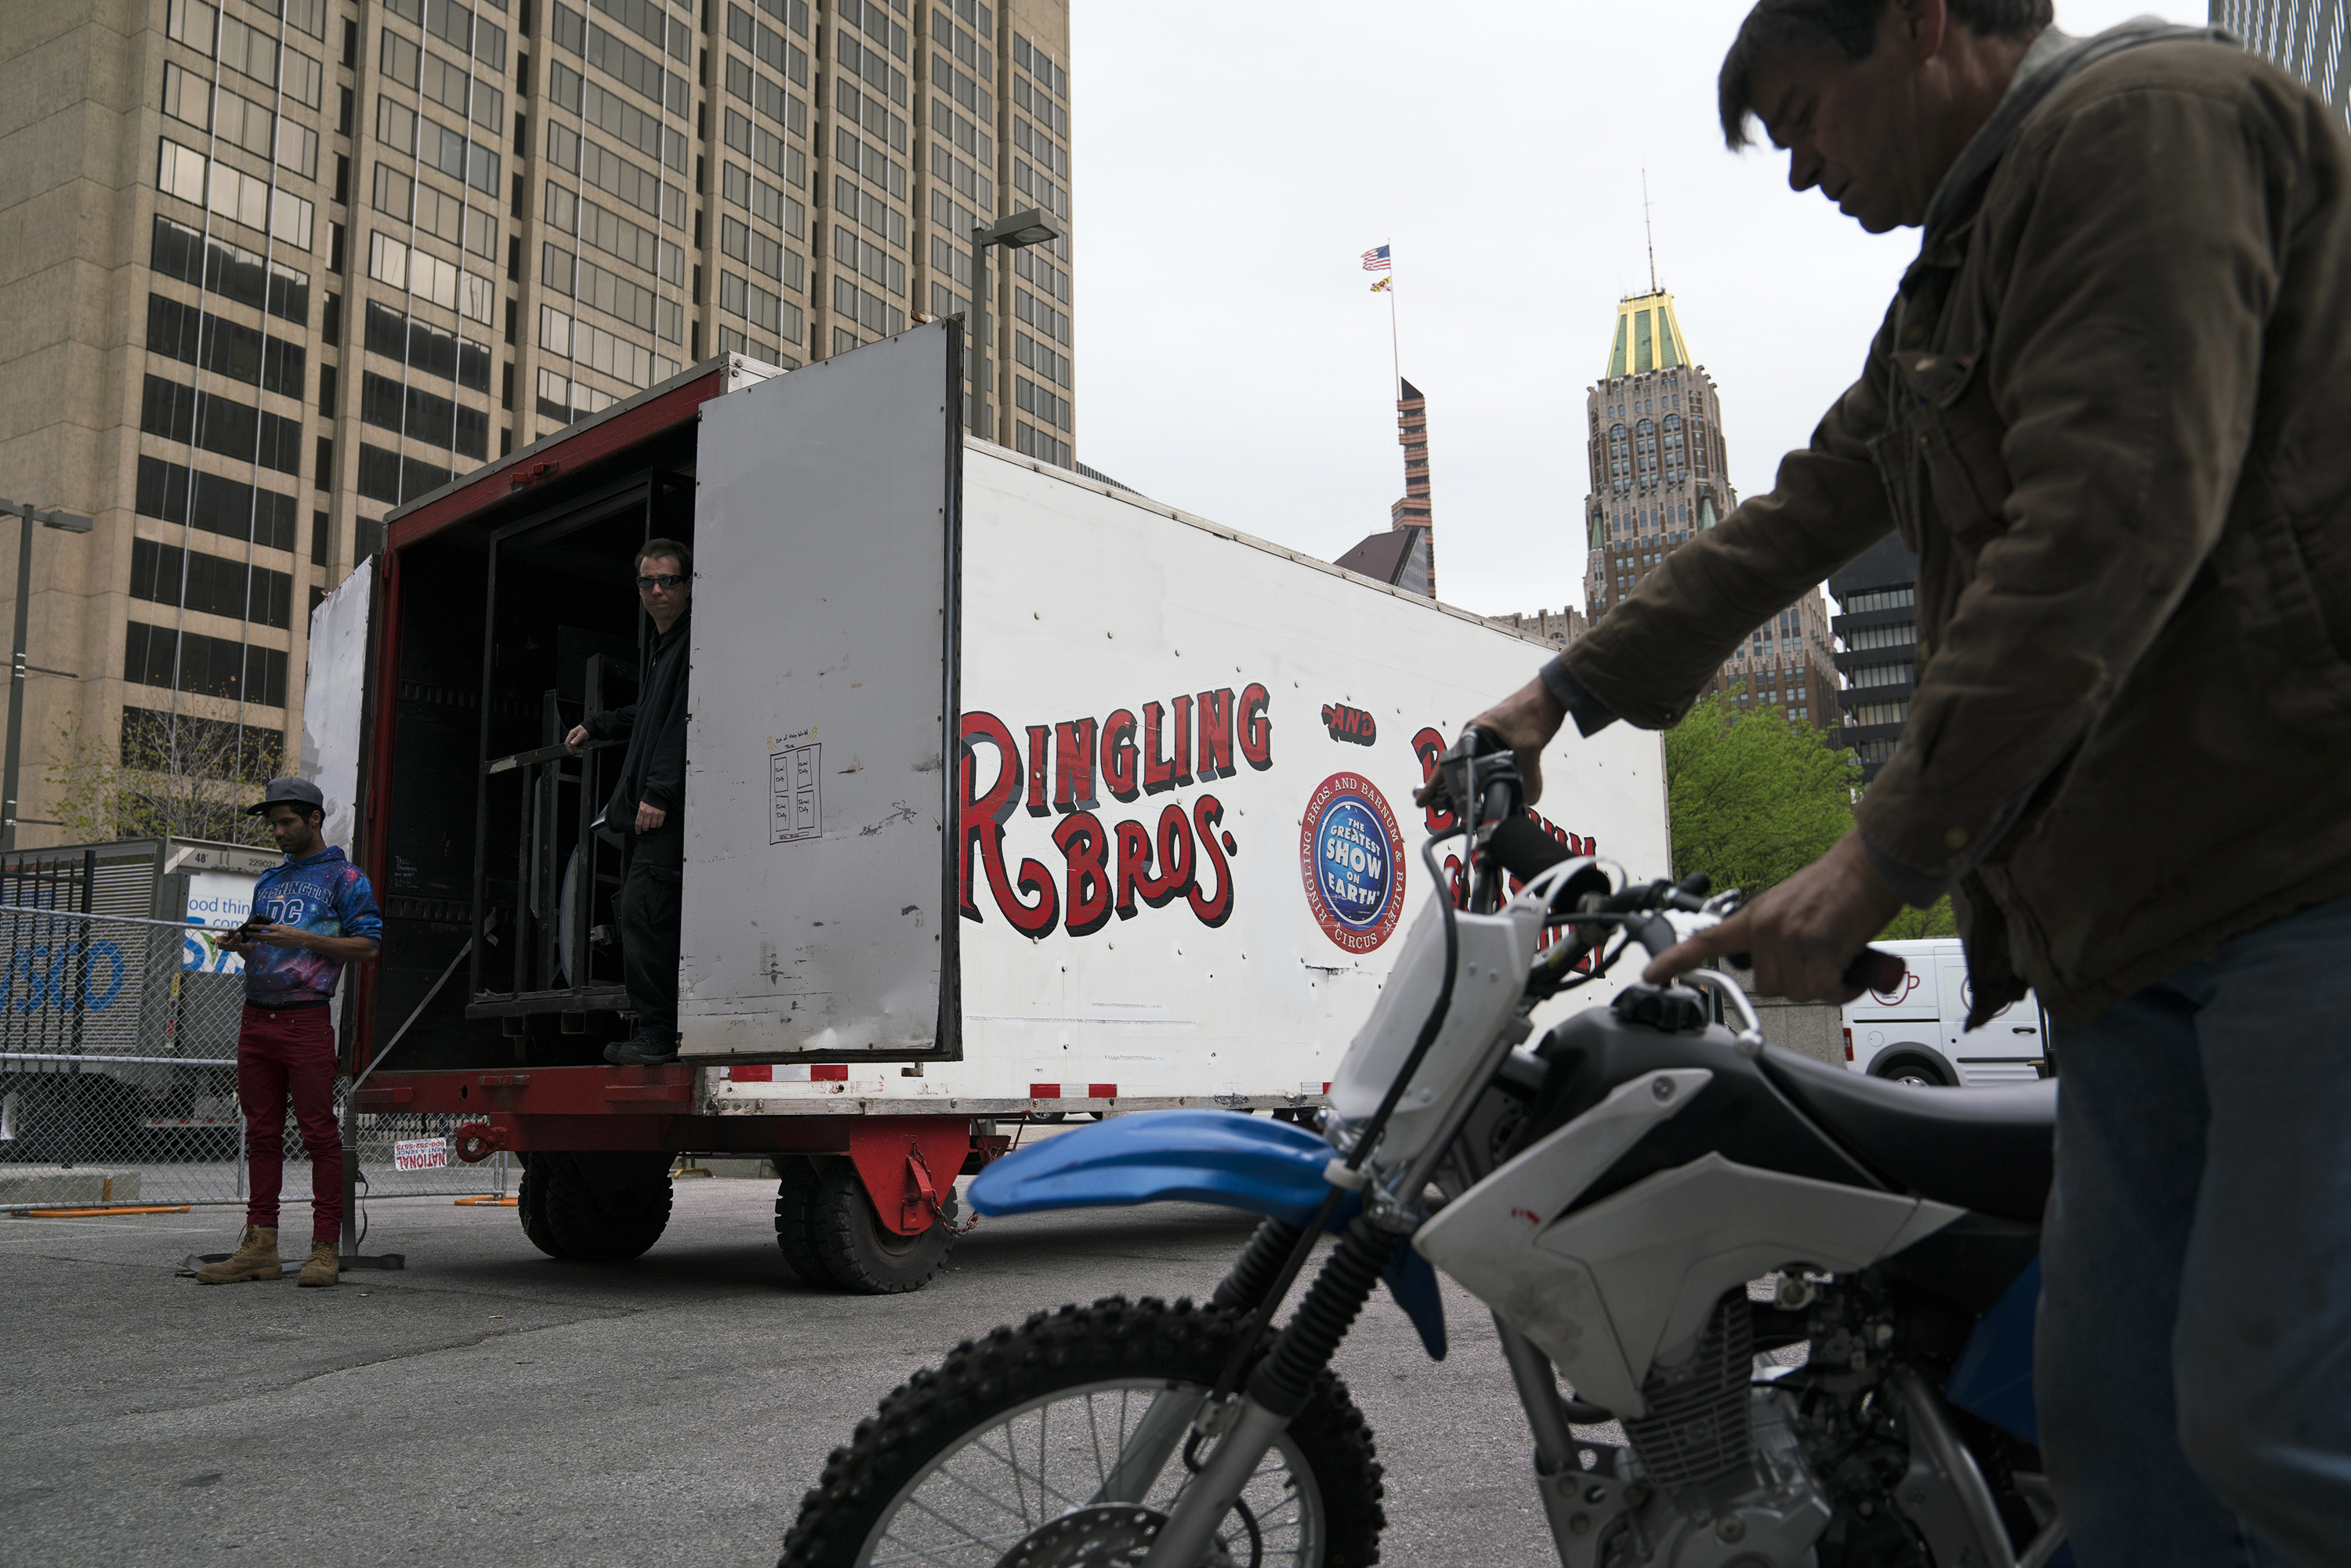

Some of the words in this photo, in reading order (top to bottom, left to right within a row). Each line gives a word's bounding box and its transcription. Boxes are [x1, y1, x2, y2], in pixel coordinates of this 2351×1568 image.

[1321, 702, 1377, 747] AND
[1335, 777, 1357, 791] AND
[960, 683, 1273, 940] RINGLING
[1307, 785, 1333, 827] BROS.
[1360, 782, 1400, 844] BARNUM
[1348, 817, 1365, 832] THE
[1331, 824, 1380, 856] GREATEST
[248, 859, 276, 869] 229021
[394, 855, 410, 865] TALL
[1052, 794, 1237, 936] BROS.
[1326, 838, 1382, 880] SHOW
[1394, 850, 1403, 863] &
[1303, 831, 1328, 924] RINGLING
[1346, 871, 1360, 885] ON
[189, 897, 219, 913] ood
[223, 900, 250, 915] thin
[265, 899, 305, 925] DC
[1383, 871, 1404, 932] BAILEY
[213, 918, 244, 928] com
[1335, 928, 1378, 949] CIRCUS
[396, 1152, 445, 1170] NATIONAL
